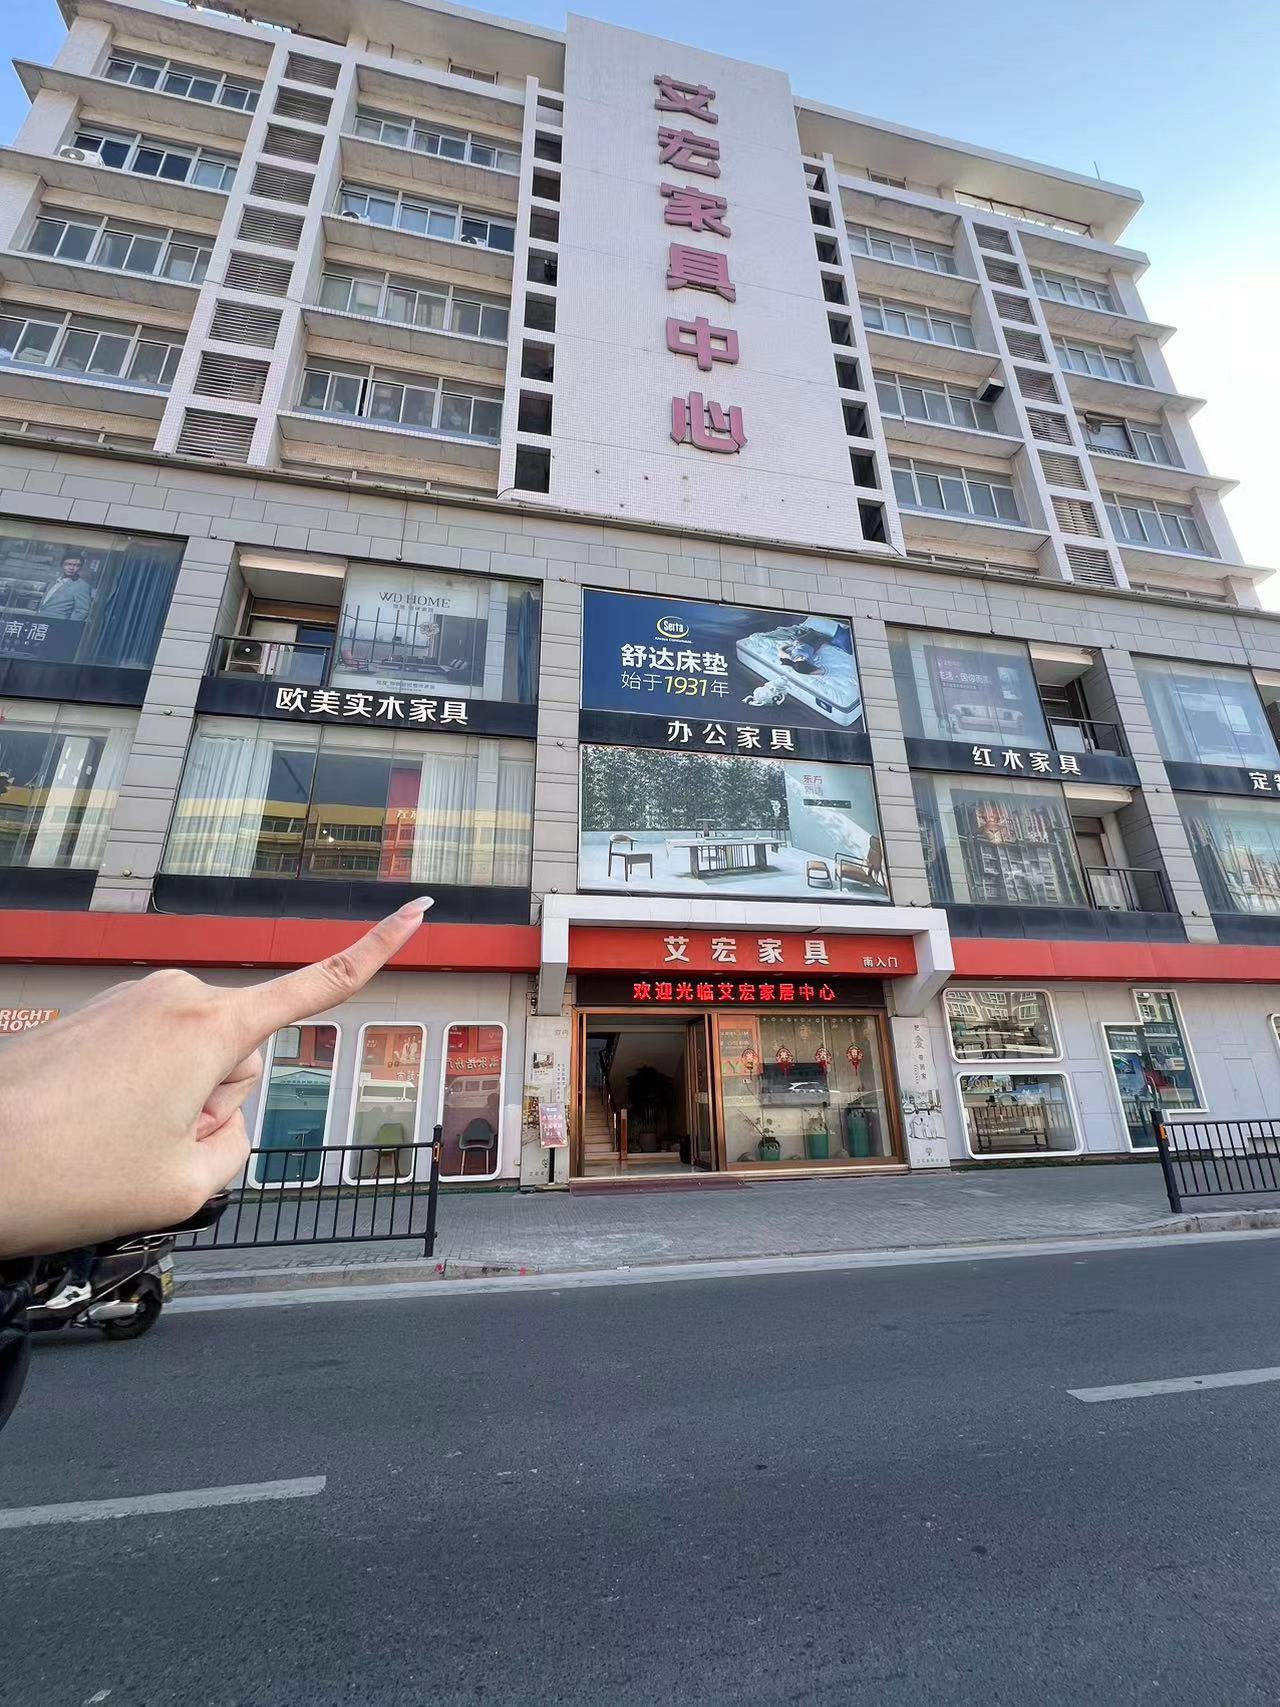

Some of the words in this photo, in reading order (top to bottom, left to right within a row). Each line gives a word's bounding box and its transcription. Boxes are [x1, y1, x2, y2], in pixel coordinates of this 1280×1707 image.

[654, 74, 748, 454] 艾宏家具中心
[407, 595, 451, 608] HOME
[663, 620, 684, 633] Serta
[621, 643, 729, 676] 舒达床垫
[275, 687, 469, 725] 欧美实木家具
[667, 721, 795, 751] 办公家具
[972, 745, 1081, 776] 红木家具
[1249, 772, 1280, 791] 定
[663, 936, 830, 965] 艾宏家具
[862, 956, 898, 968] 南入门
[633, 981, 836, 1001] 欢迎光临艾宏家居中心
[0, 1020, 48, 1031] HOM
